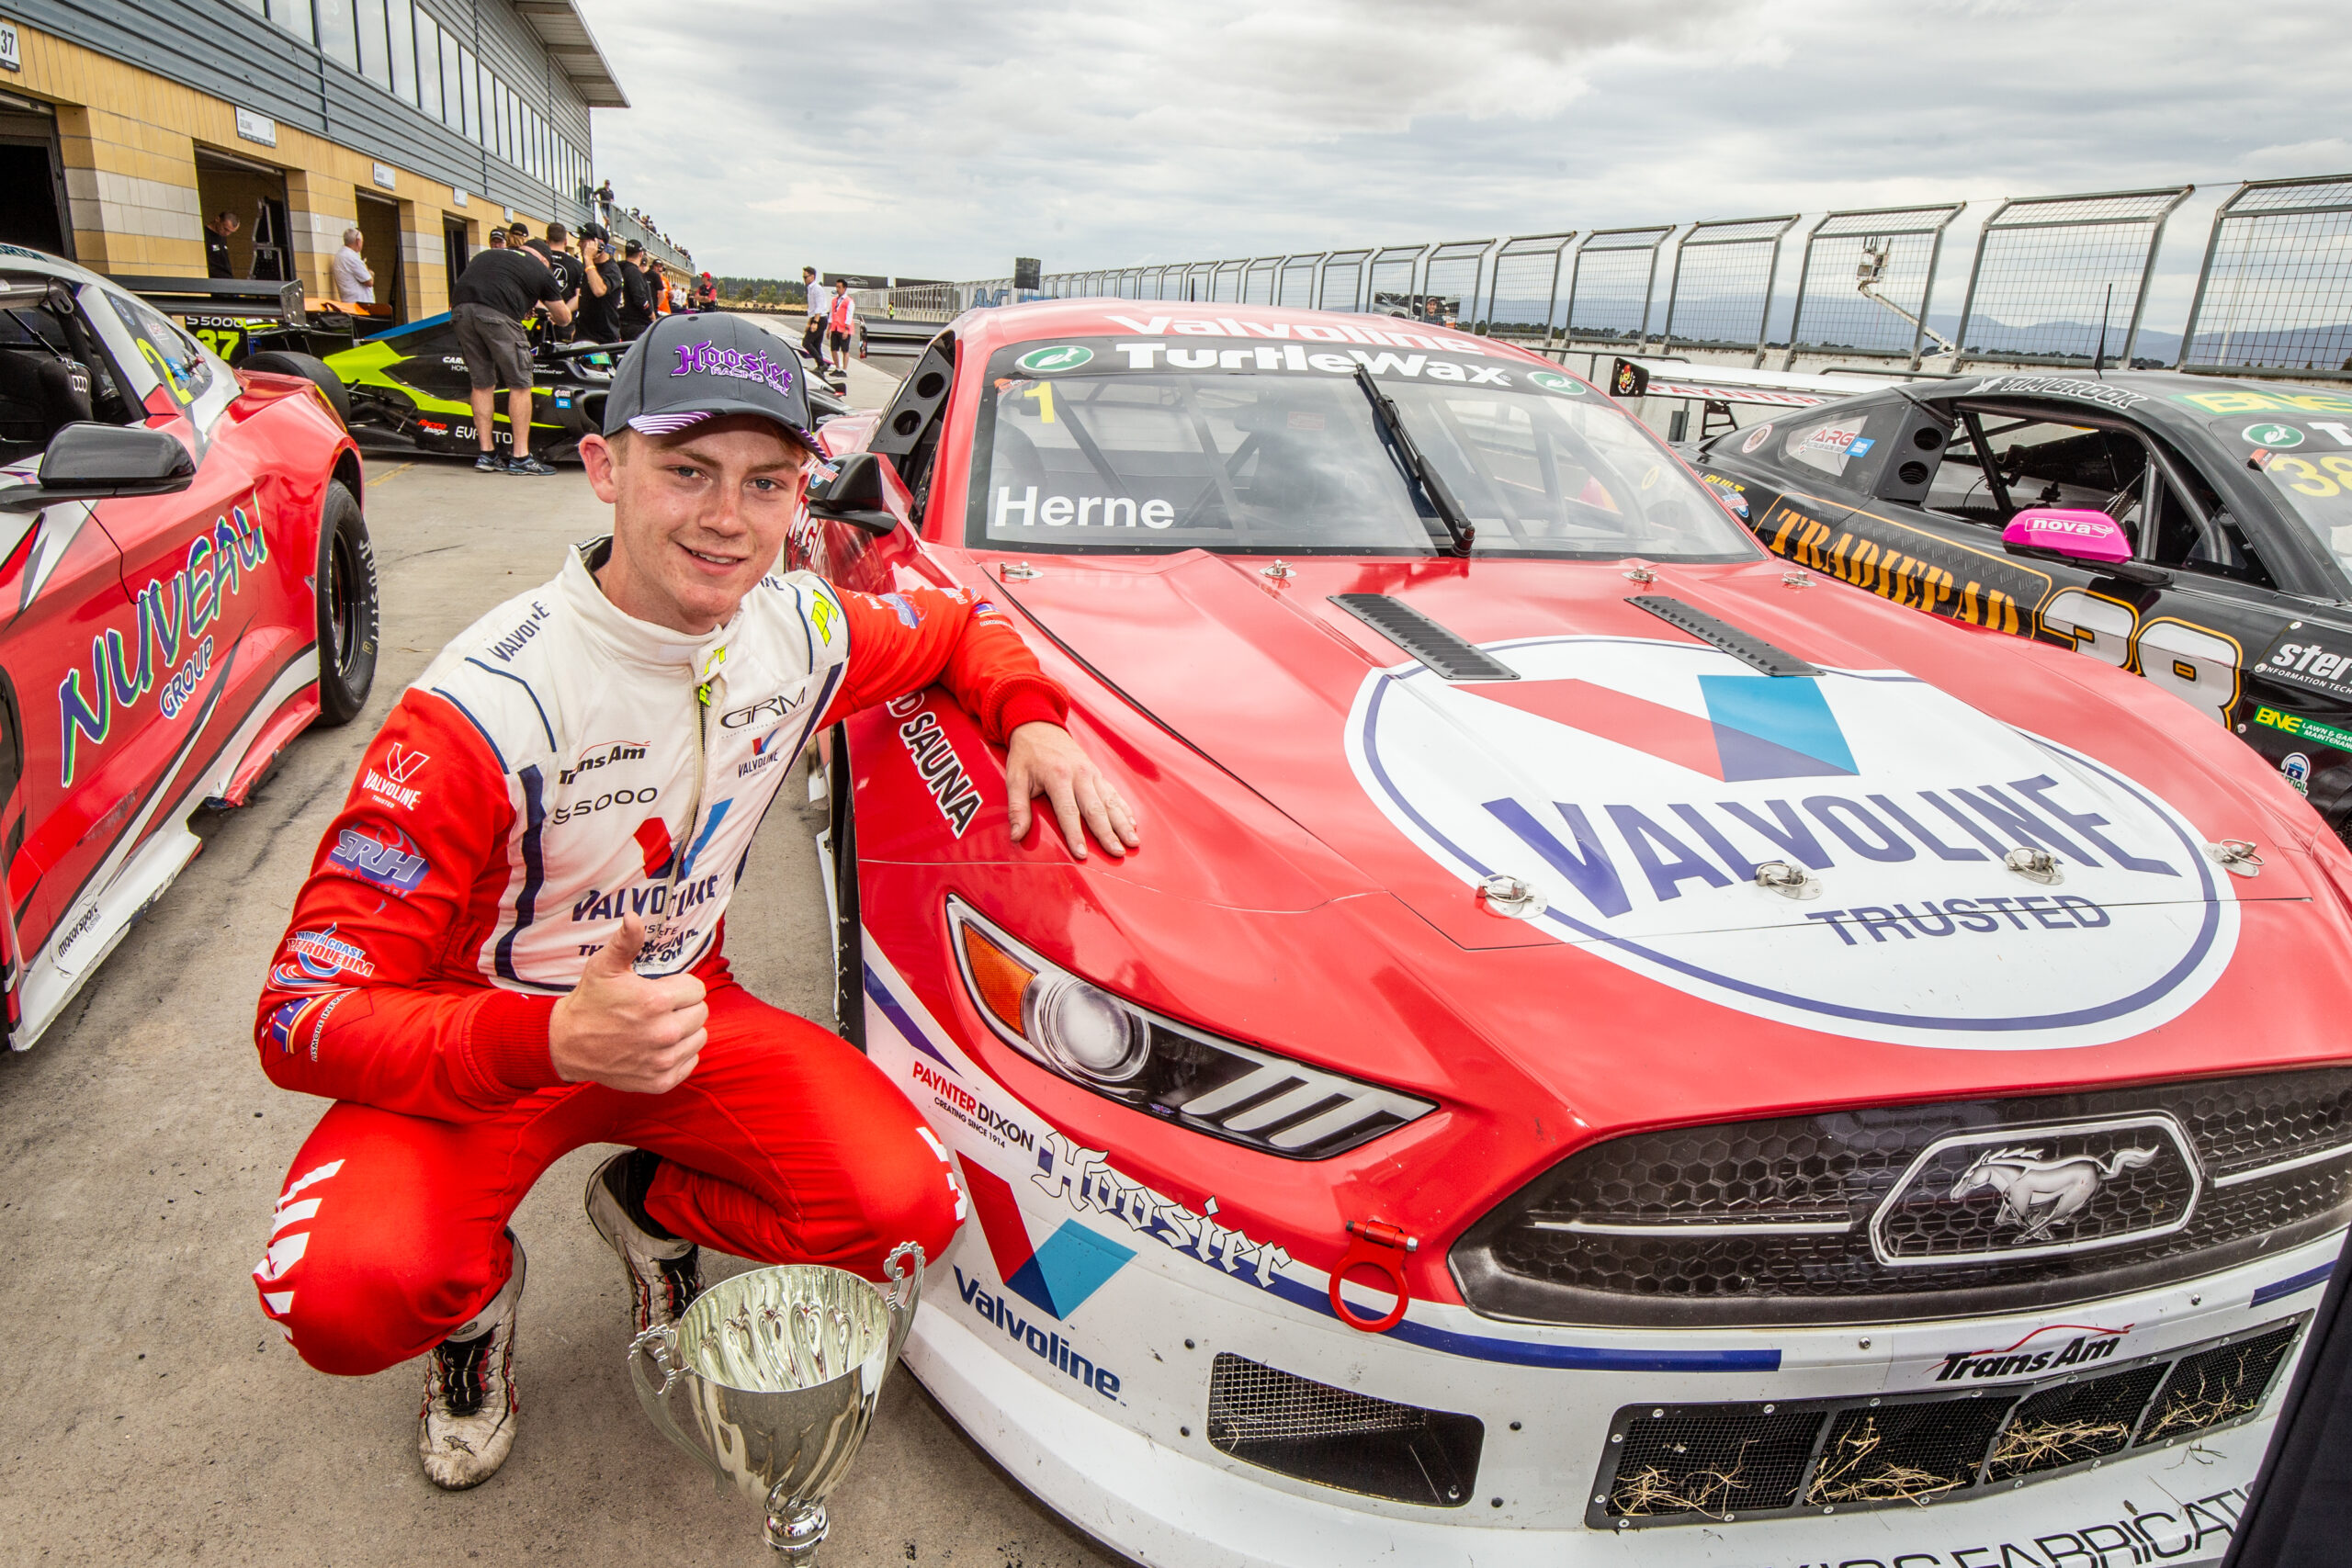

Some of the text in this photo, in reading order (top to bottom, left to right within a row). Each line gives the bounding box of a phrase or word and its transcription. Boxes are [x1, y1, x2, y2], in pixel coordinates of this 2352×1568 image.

[1, 29, 15, 55] 37
[187, 315, 243, 328] S5000
[1105, 315, 1485, 355] Valvoline
[196, 329, 239, 360] 37
[670, 340, 793, 390] Hoosier
[1023, 381, 1056, 423] 1
[2000, 377, 2149, 410] TIM BROOK
[1811, 429, 1856, 446] ARG
[994, 486, 1175, 530] Herne
[2032, 519, 2092, 535] nova
[1768, 508, 2020, 636] TRADIEPAD
[60, 487, 268, 789] NUVEAU
[159, 635, 214, 720] GROUP
[2262, 665, 2327, 688] NFORMATION
[2271, 643, 2352, 685] ster
[720, 686, 806, 728] GRM
[2256, 706, 2303, 733] BNE
[2301, 722, 2328, 737] LAWN
[2327, 729, 2335, 738] &
[607, 745, 646, 765] Am
[739, 747, 780, 779] VALVOLINE
[899, 711, 984, 840] SAUNA
[362, 768, 422, 811] VALVOLINE
[552, 787, 658, 825] S5000
[331, 829, 426, 883] SRH
[1481, 773, 2184, 919] VALVOLINE
[1806, 895, 2112, 946] TRUSTED
[286, 938, 376, 977] PETROLEUM
[296, 931, 367, 959] NORTH COAST
[311, 1020, 325, 1063] LISMORE
[912, 1060, 1035, 1153] PAYNTER DIXON
[934, 1097, 1006, 1149] CREATING SINCE 1914
[1030, 1131, 1293, 1289] Hoosier
[953, 1263, 1122, 1403] Valvoline
[1936, 1336, 2121, 1382] Trans Am
